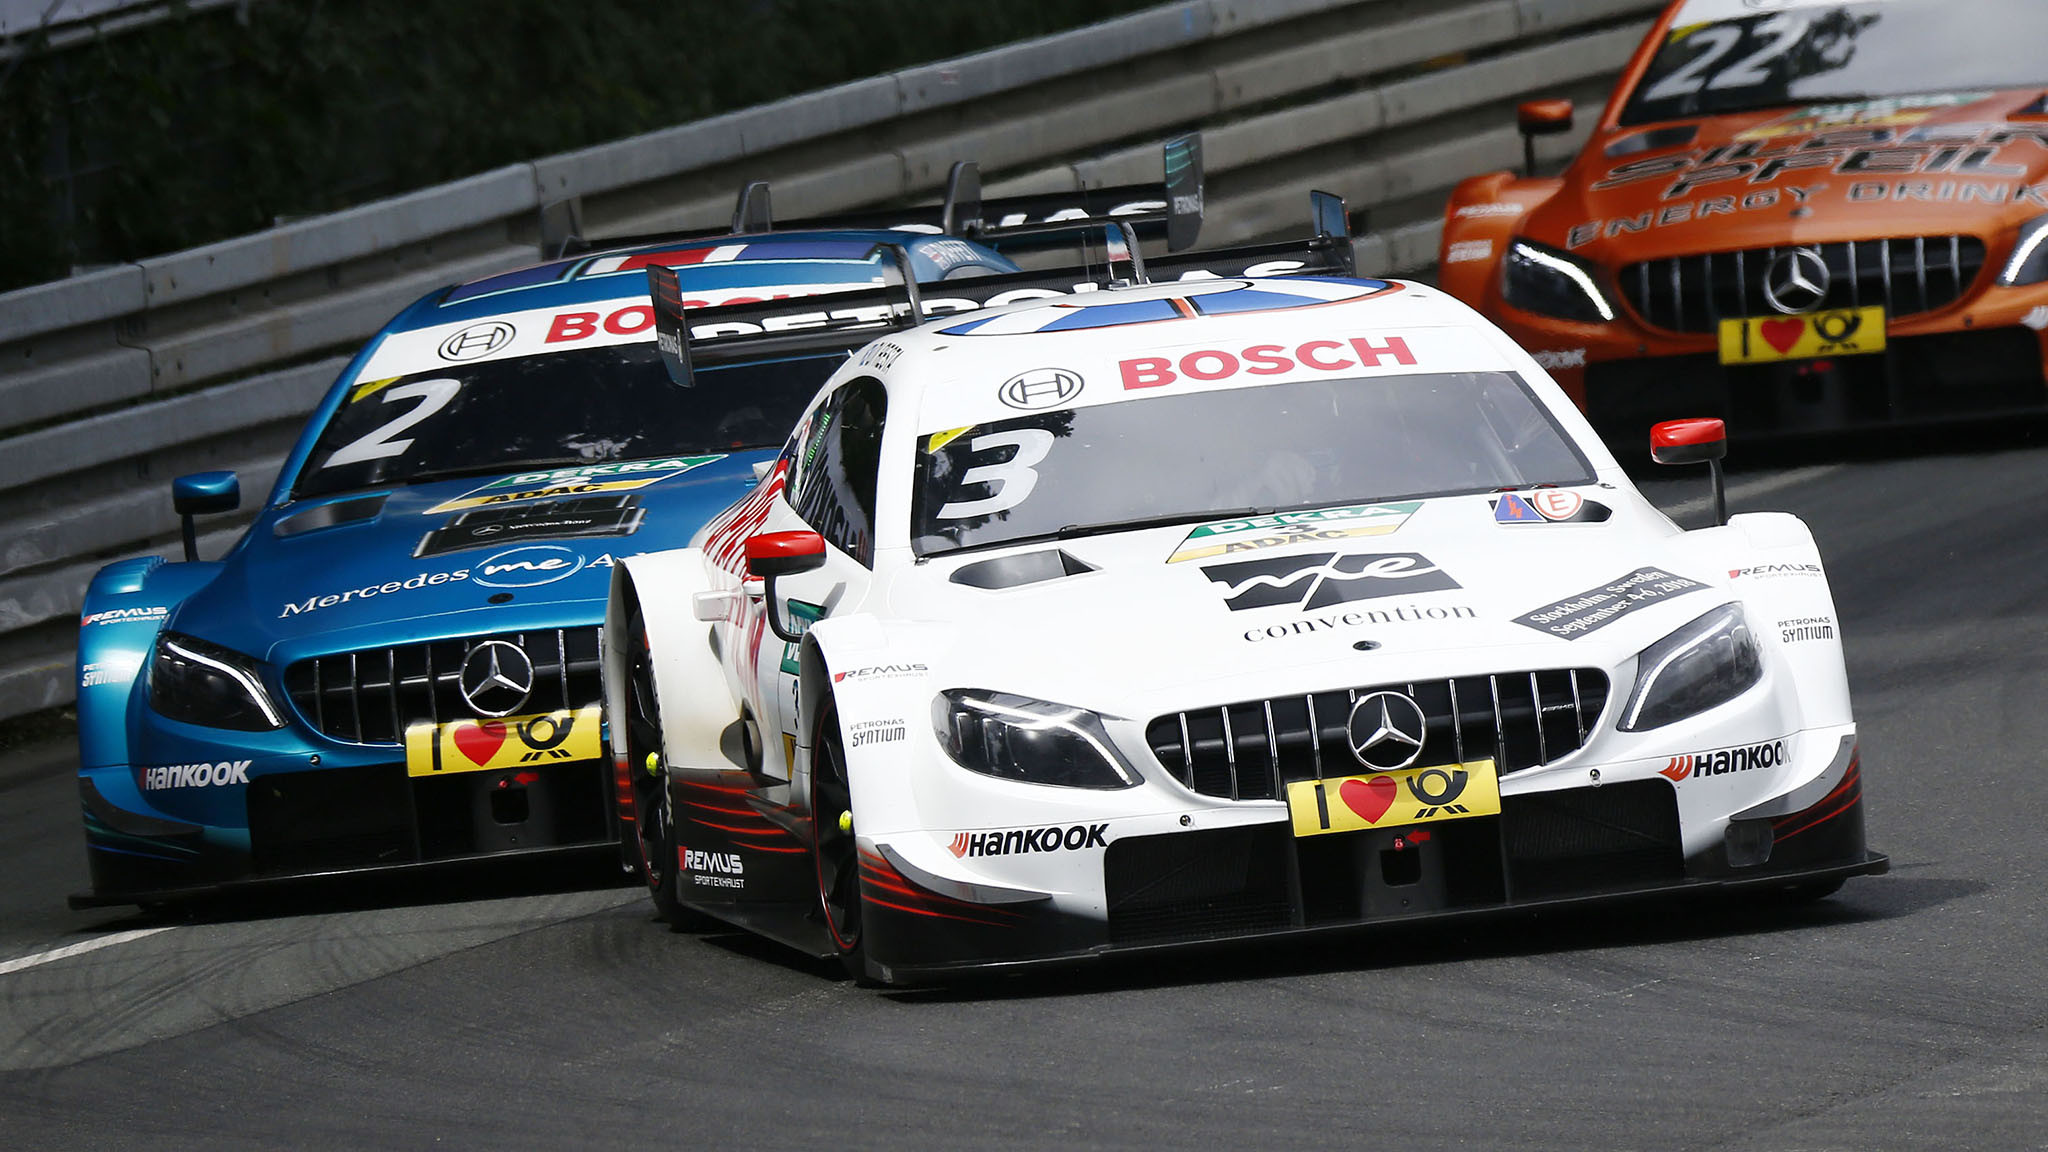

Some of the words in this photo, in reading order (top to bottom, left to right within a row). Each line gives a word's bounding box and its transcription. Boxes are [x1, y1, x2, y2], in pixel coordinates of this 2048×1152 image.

[1645, 9, 1811, 101] 22
[1566, 182, 1829, 250] ENERGY
[1846, 180, 2048, 212] DRINK
[1118, 336, 1418, 391] BOSCH
[321, 378, 462, 469] 2
[512, 459, 689, 485] DEKRA
[936, 428, 1055, 519] 3
[485, 484, 603, 504] ADAC
[1207, 507, 1400, 535] DEKRA
[1225, 530, 1350, 554] ADAC
[1738, 564, 1822, 578] REMUS
[277, 568, 470, 619] Mercedes
[1530, 592, 1619, 625] Stockholm,
[1606, 570, 1669, 595] Sweden
[87, 606, 168, 625] REMUS
[1550, 599, 1633, 635] September
[1655, 578, 1698, 594] 2018
[1244, 604, 1479, 643] convention
[1778, 616, 1831, 628] PETRONAS
[1782, 625, 1834, 643] SYNTIUM
[843, 664, 929, 681] REMUS
[850, 718, 905, 731] PETRONAS
[852, 727, 906, 748] SYNTIUM
[684, 849, 744, 874] REMUS
[694, 874, 745, 889] SPORTEXHAUST
